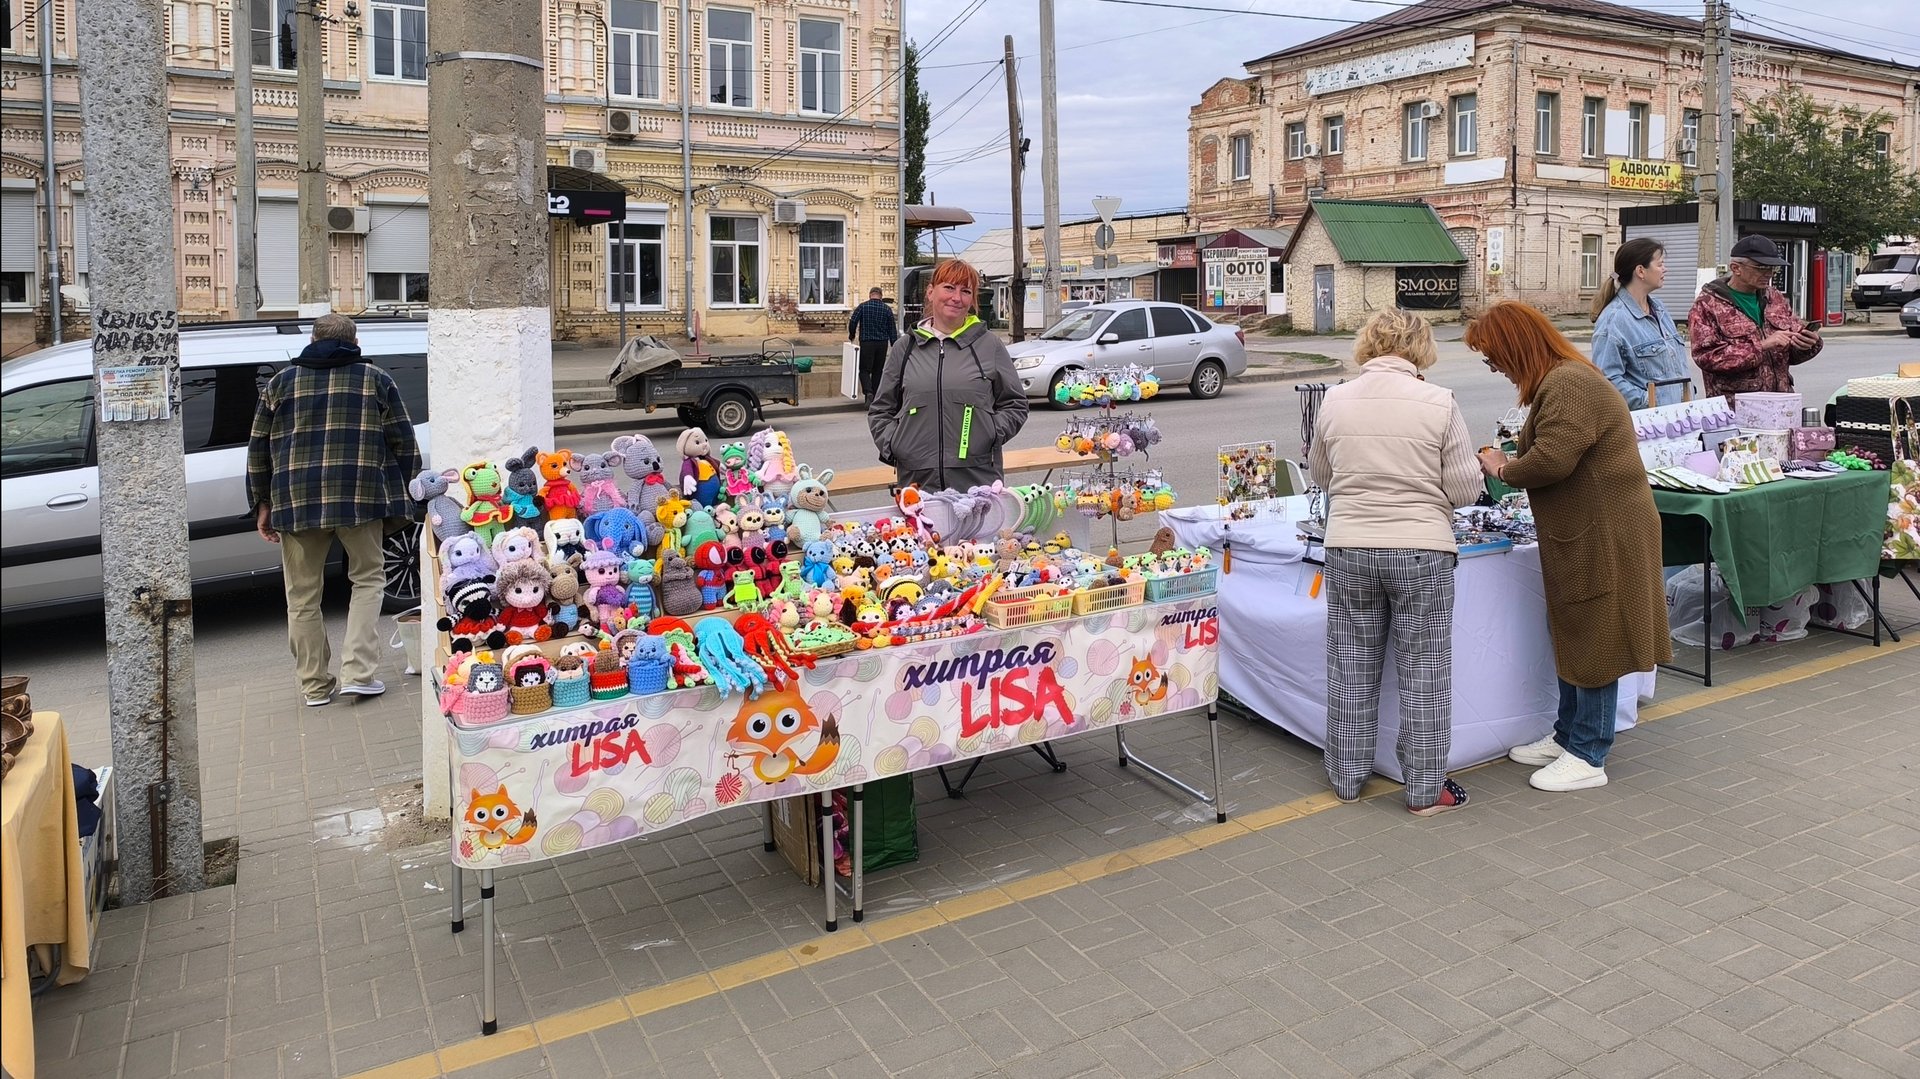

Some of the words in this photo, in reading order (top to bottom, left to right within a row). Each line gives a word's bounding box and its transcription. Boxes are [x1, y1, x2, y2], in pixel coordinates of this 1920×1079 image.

[1621, 162, 1670, 176] АДВОКАТ
[1762, 204, 1779, 220] БЛИН
[1781, 206, 1786, 221] &
[1789, 206, 1816, 223] ШАУРМА
[1226, 261, 1264, 275] ФОТО
[1399, 278, 1457, 291] SMOKE
[1161, 606, 1217, 627] хитра
[1184, 617, 1219, 649] LIS
[904, 641, 1057, 692] хитрая
[960, 666, 1076, 739] LISA
[530, 713, 640, 751] хитрая
[570, 729, 653, 778] LISA
